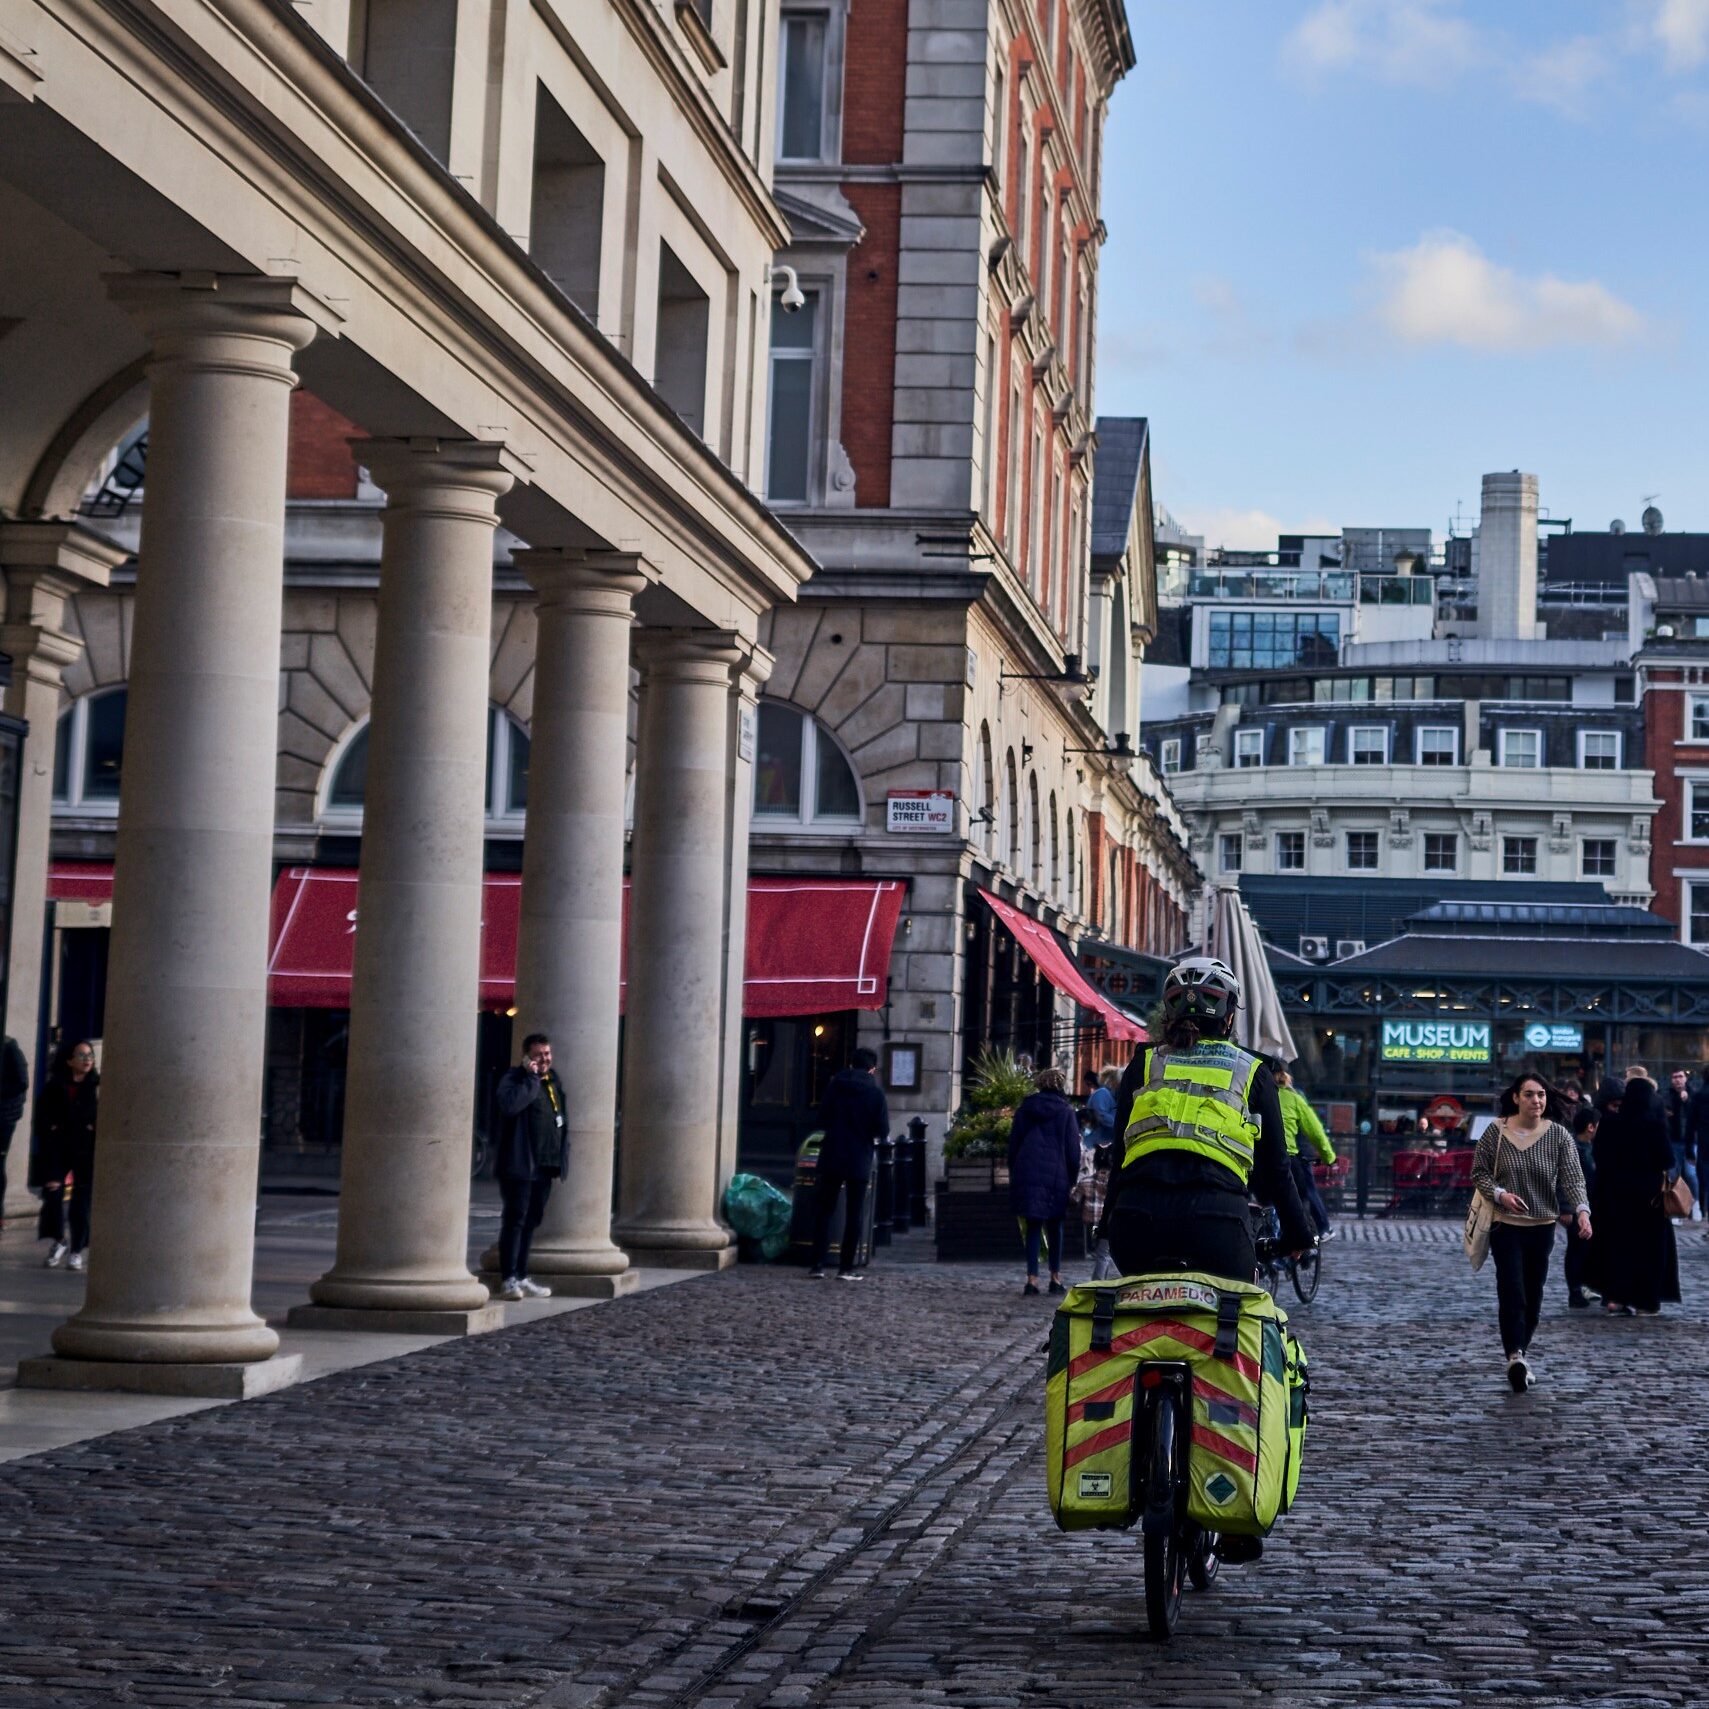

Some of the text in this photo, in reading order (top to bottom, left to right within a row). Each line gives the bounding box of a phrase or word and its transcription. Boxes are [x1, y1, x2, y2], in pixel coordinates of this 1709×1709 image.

[893, 802, 931, 811] RUSSELL
[893, 812, 947, 822] STREET WC2
[1384, 1023, 1489, 1047] MUSEUM
[1384, 1048, 1488, 1061] CAFE SHOP EVENTS
[1120, 1287, 1215, 1304] PARAMEDIC
